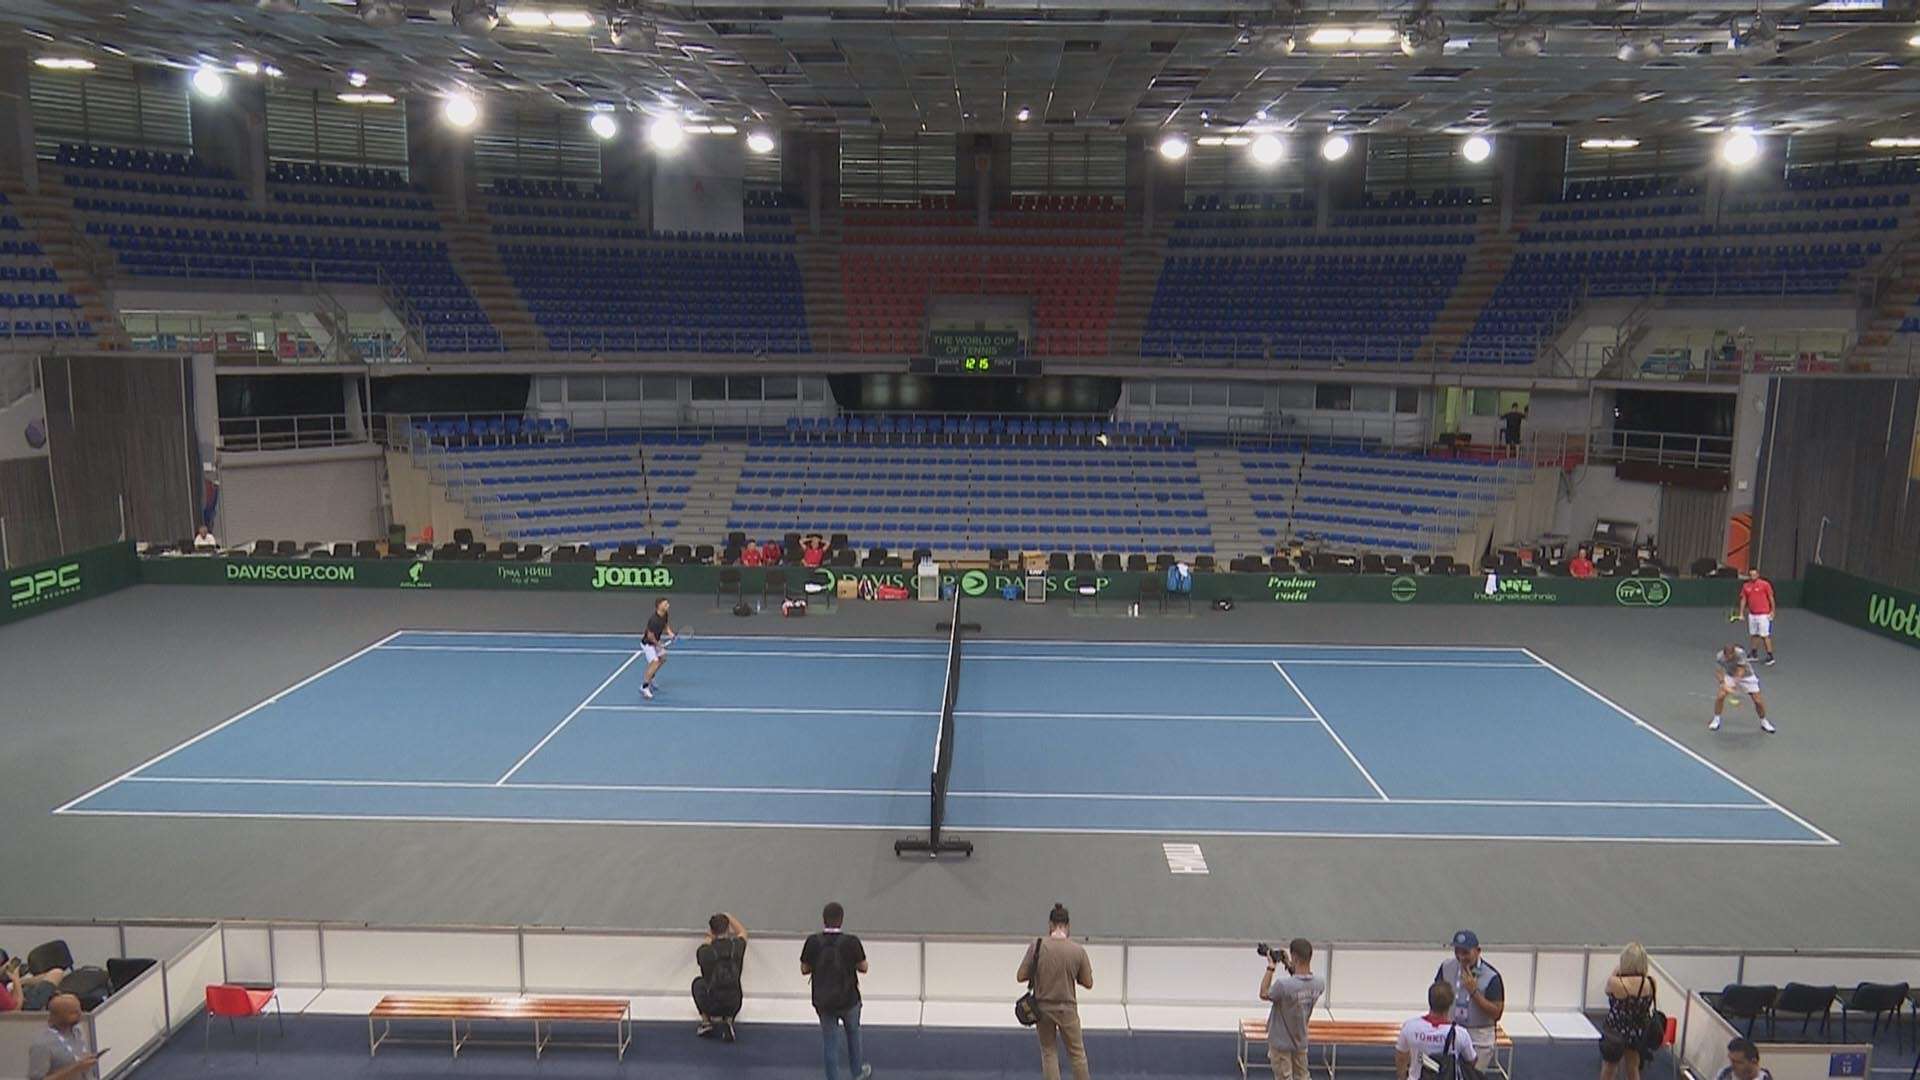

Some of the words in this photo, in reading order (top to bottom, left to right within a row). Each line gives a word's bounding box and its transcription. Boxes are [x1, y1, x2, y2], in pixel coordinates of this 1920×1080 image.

[934, 335, 953, 345] THE
[954, 335, 991, 345] WORLD
[993, 335, 1015, 345] CUP
[945, 346, 960, 355] OF
[962, 346, 998, 355] TENNIS
[965, 358, 976, 369] 12
[979, 358, 989, 369] 15
[226, 564, 355, 581] DAVISCUP.COM
[592, 565, 673, 589] Joma
[995, 576, 1057, 591] DAS
[1064, 576, 1110, 591] CP
[1268, 576, 1316, 588] Prolom
